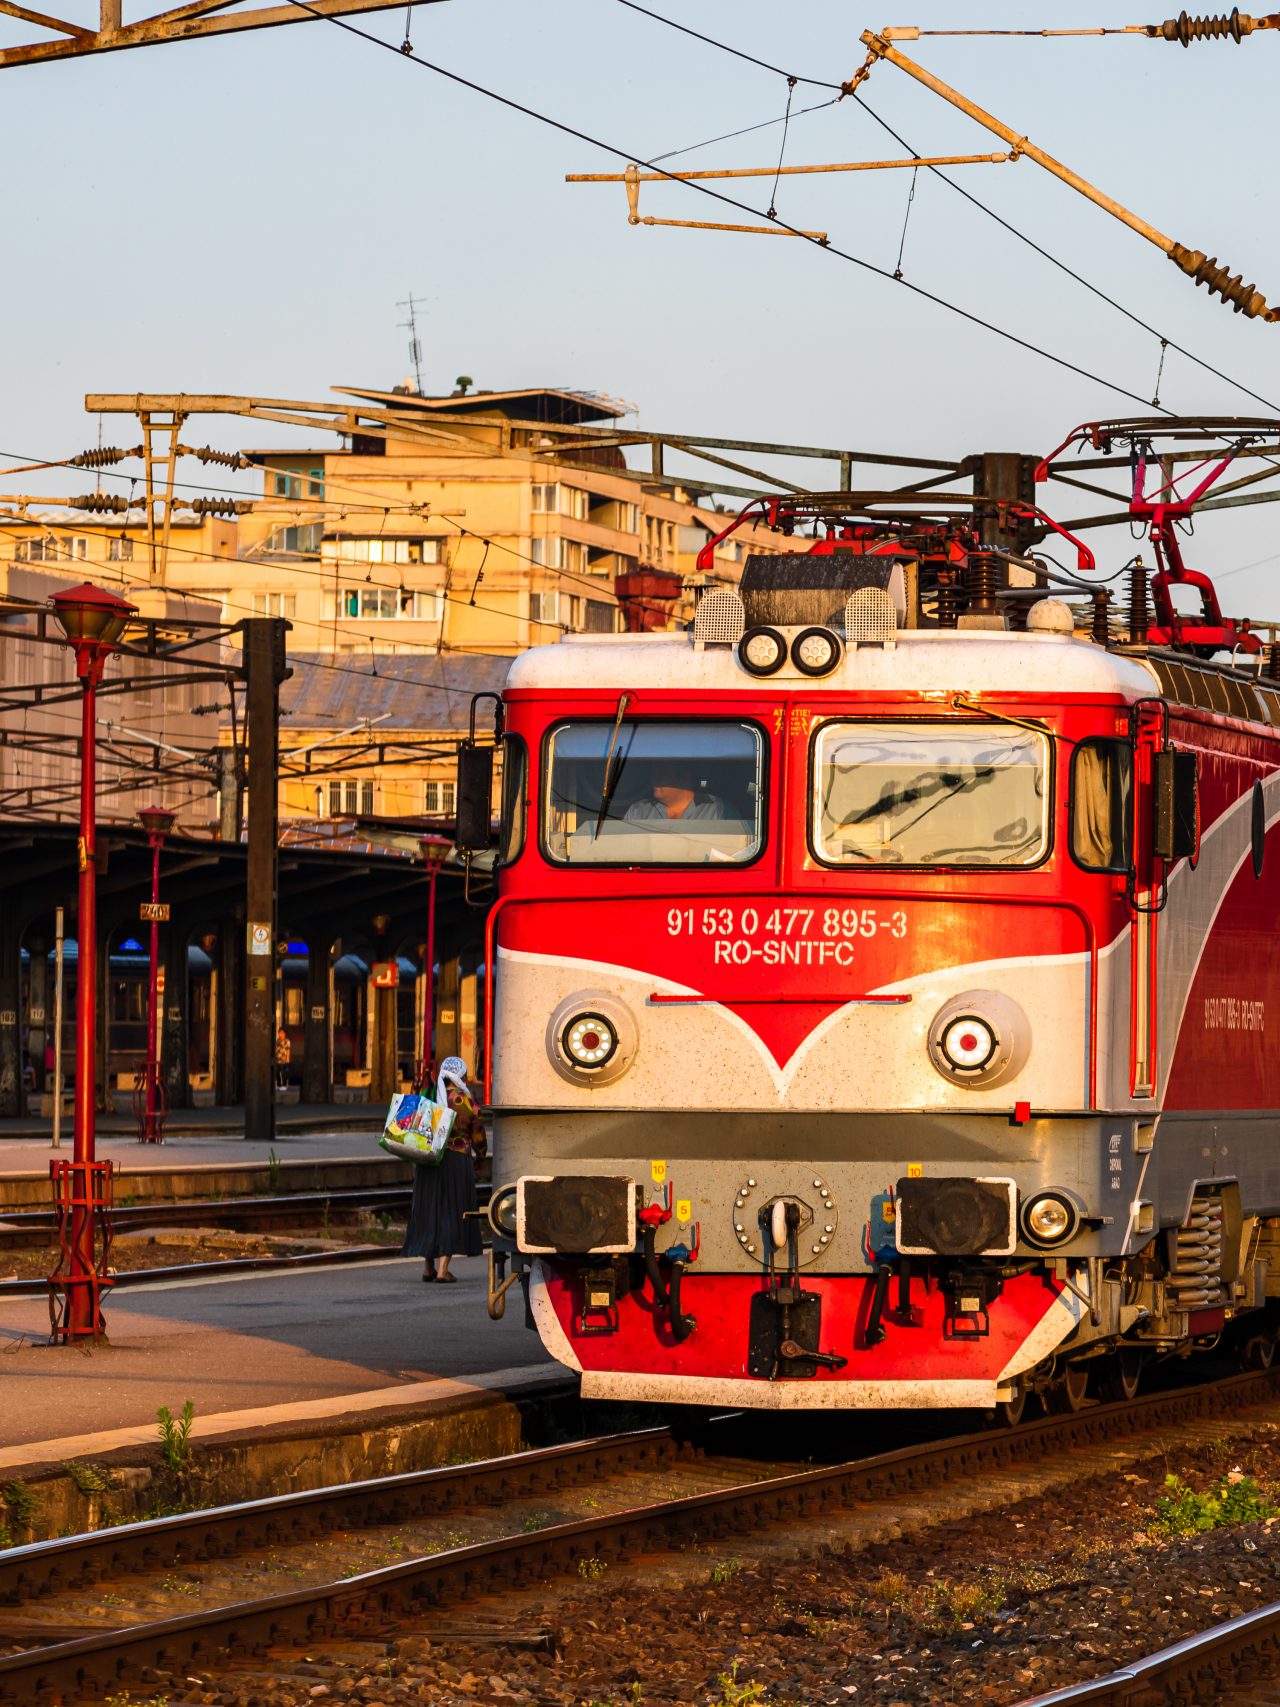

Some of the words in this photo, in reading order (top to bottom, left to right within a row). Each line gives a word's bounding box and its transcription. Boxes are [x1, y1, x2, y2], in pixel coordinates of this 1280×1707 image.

[667, 908, 694, 936] 91
[702, 908, 733, 936] 53
[741, 908, 758, 935] 0
[765, 908, 815, 936] 477
[823, 908, 907, 938] 895-3
[714, 940, 854, 965] RO-SNTFC
[653, 1165, 664, 1175] 10
[910, 1168, 921, 1177] 10
[680, 1205, 688, 1215] 5
